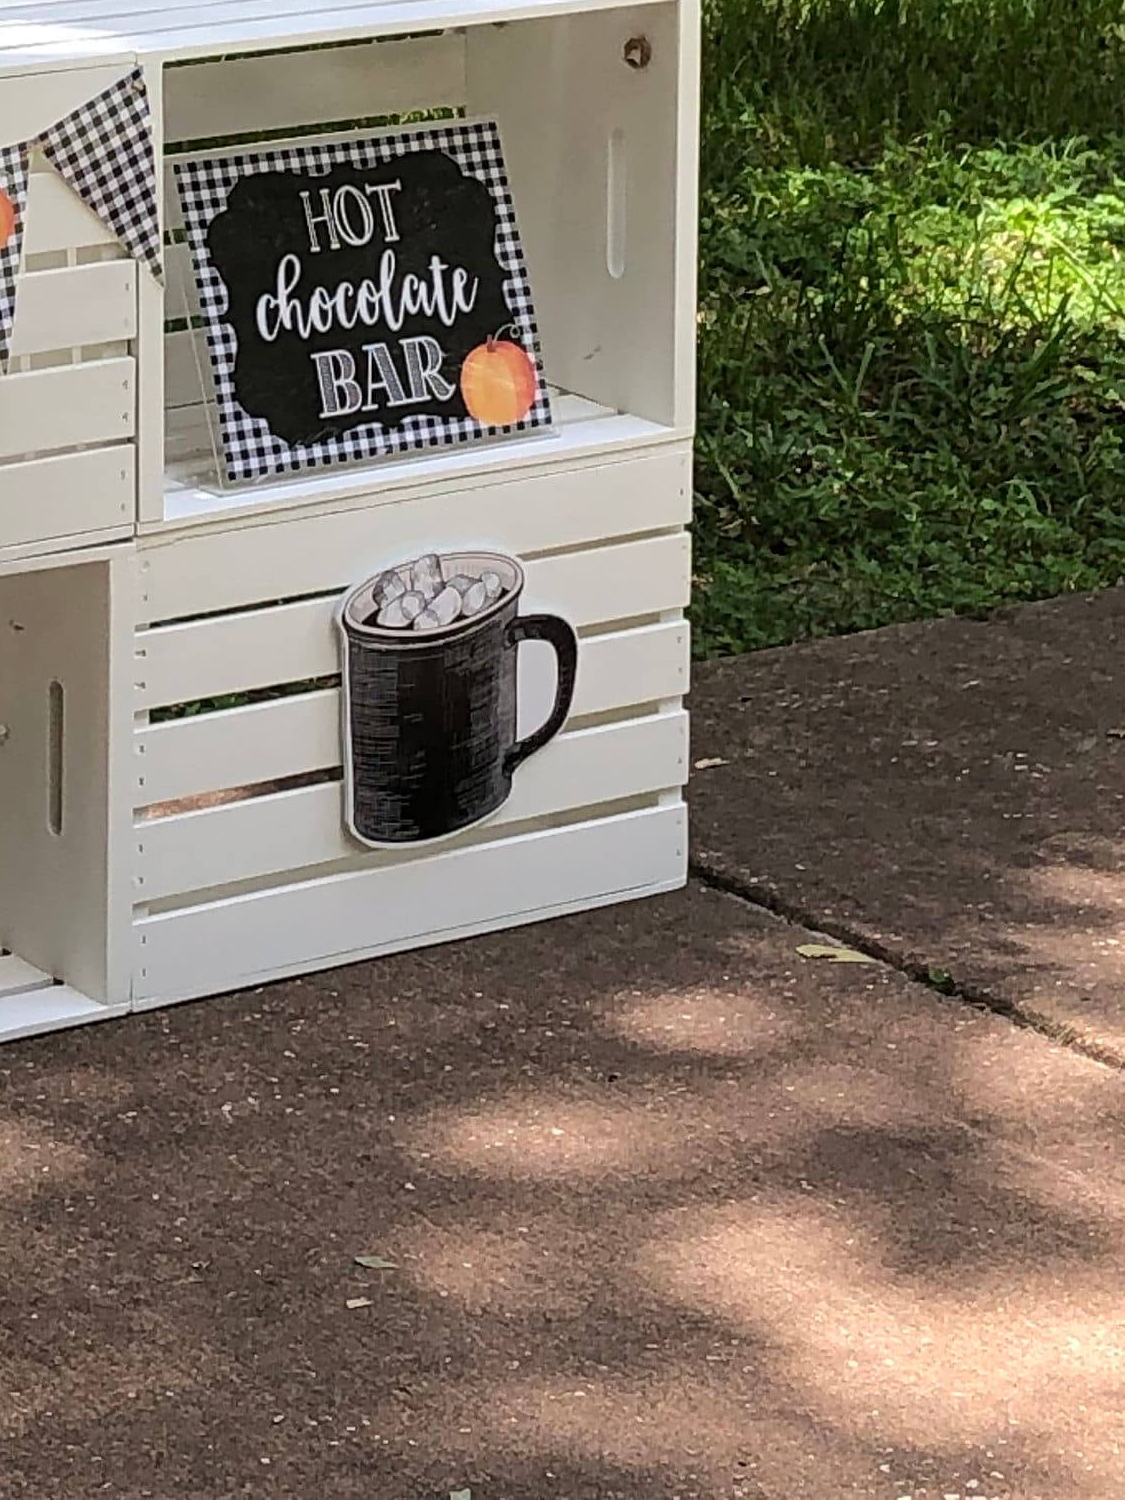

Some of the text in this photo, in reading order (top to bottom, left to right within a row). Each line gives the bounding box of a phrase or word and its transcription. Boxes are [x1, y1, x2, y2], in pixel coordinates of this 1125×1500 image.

[299, 178, 402, 252] HOT
[256, 249, 479, 342] chocolate
[310, 335, 456, 419] BAR
